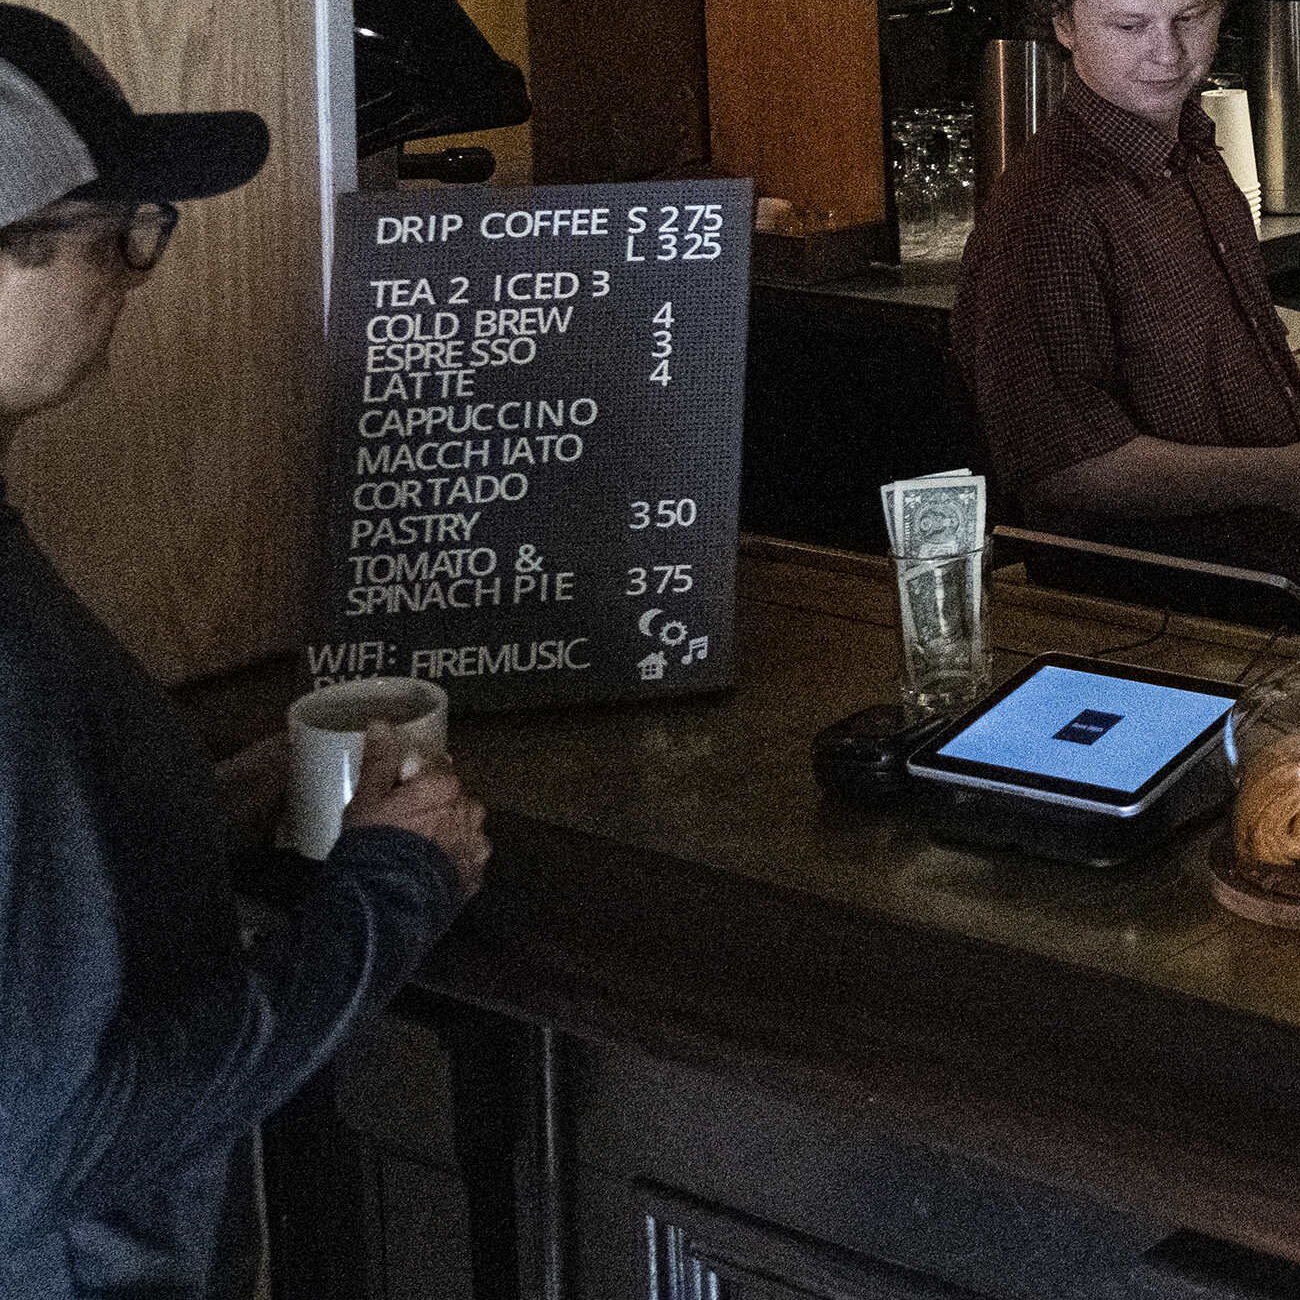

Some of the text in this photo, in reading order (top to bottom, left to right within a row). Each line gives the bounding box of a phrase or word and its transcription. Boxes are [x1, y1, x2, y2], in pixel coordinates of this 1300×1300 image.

[376, 212, 463, 245] DRIP
[479, 207, 610, 240] COFFEE
[627, 206, 648, 234] S
[626, 234, 644, 262] L
[370, 270, 610, 308] TEA 2 ICED 3
[367, 301, 675, 343] COLD BREW 4
[366, 331, 672, 373] ESPRESSO 3
[363, 360, 672, 403] LATTE 4
[358, 398, 598, 439] CAPPUCCINO
[352, 472, 529, 512] CORTADO
[350, 511, 481, 550] PASTRY
[348, 544, 544, 585] TOMATO &
[345, 576, 501, 617] SPINACH
[511, 570, 575, 605] PIE
[410, 636, 591, 681] FIREMUSIC
